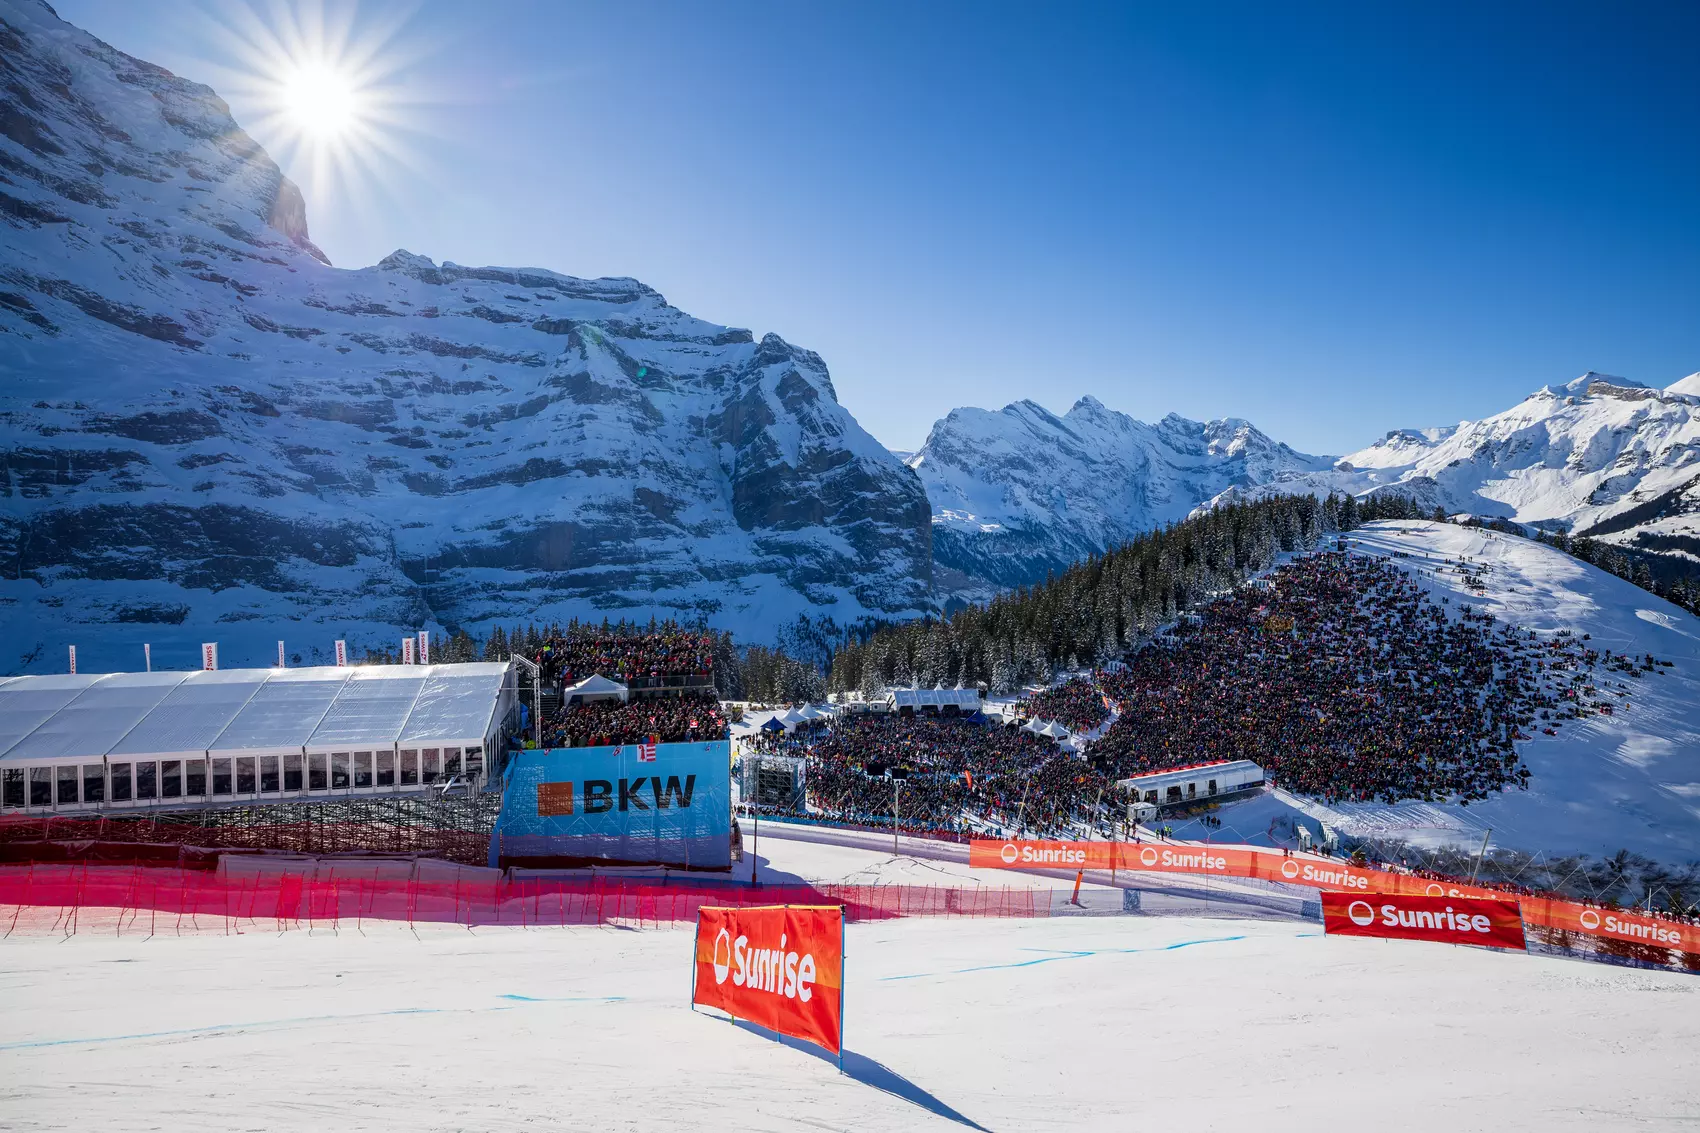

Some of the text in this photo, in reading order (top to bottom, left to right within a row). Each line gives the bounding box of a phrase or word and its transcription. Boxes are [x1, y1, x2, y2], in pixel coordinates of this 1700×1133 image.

[583, 775, 697, 814] BKW
[1022, 845, 1086, 863] Sunrise
[1162, 849, 1226, 870] Sunrise
[1302, 864, 1368, 889] Sunrise
[1381, 904, 1491, 933] Sunrise
[1604, 916, 1681, 944] Sunrise
[732, 933, 817, 1003] Sunrise
